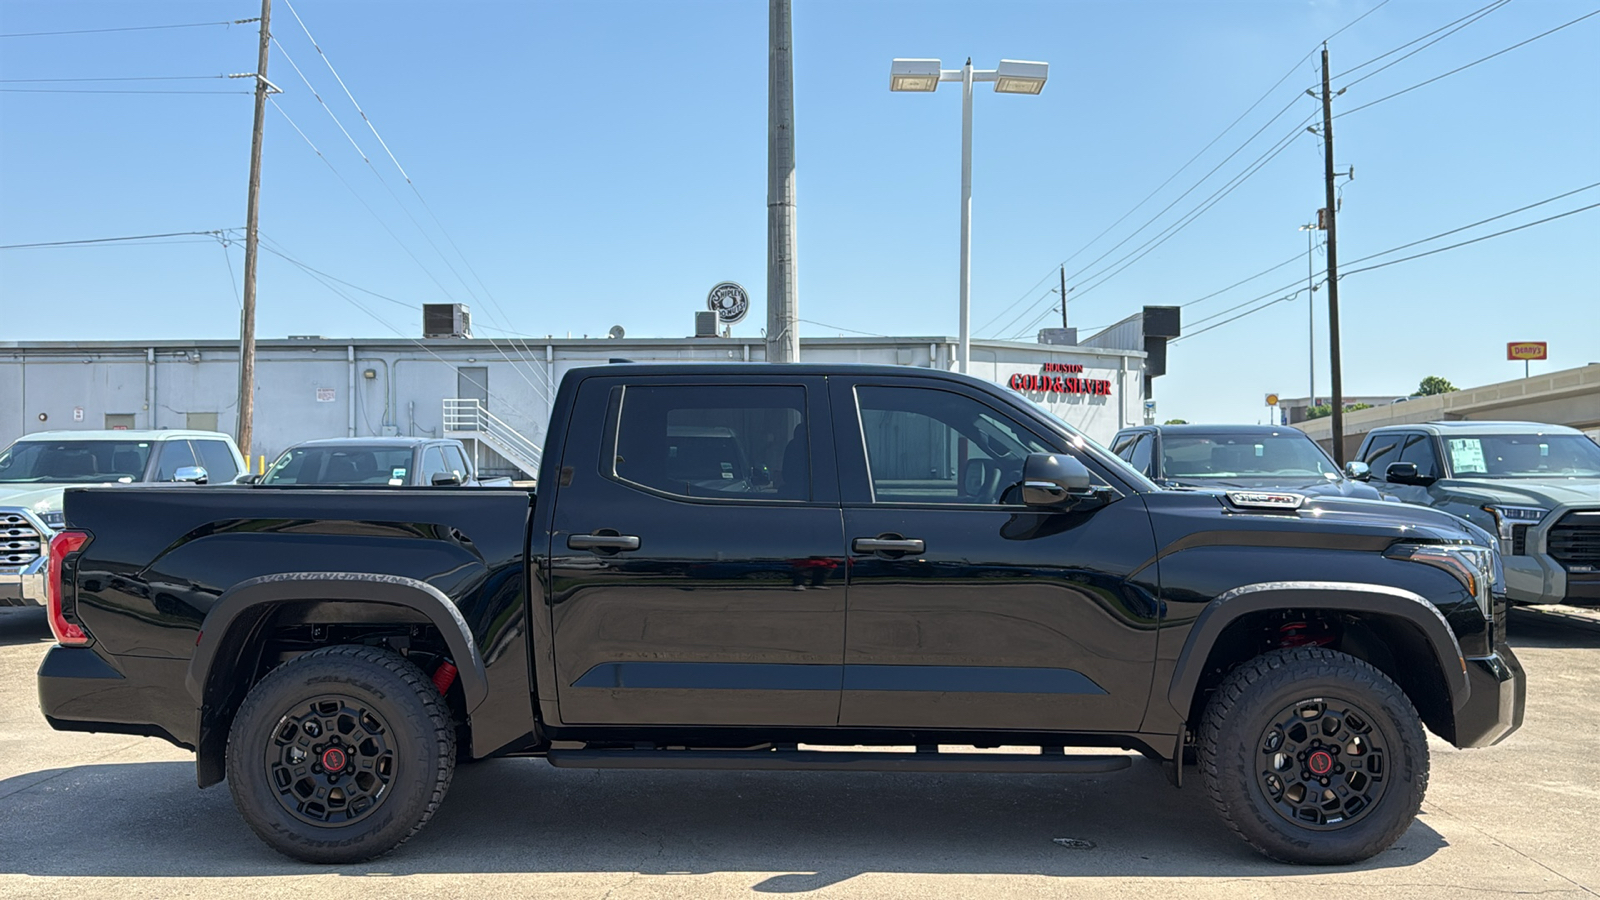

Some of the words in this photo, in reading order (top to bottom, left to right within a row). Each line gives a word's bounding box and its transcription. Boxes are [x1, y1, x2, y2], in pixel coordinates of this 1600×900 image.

[713, 288, 742, 302] SHIPLEY
[1514, 346, 1541, 355] Denny's
[1044, 363, 1083, 373] HOUSTON
